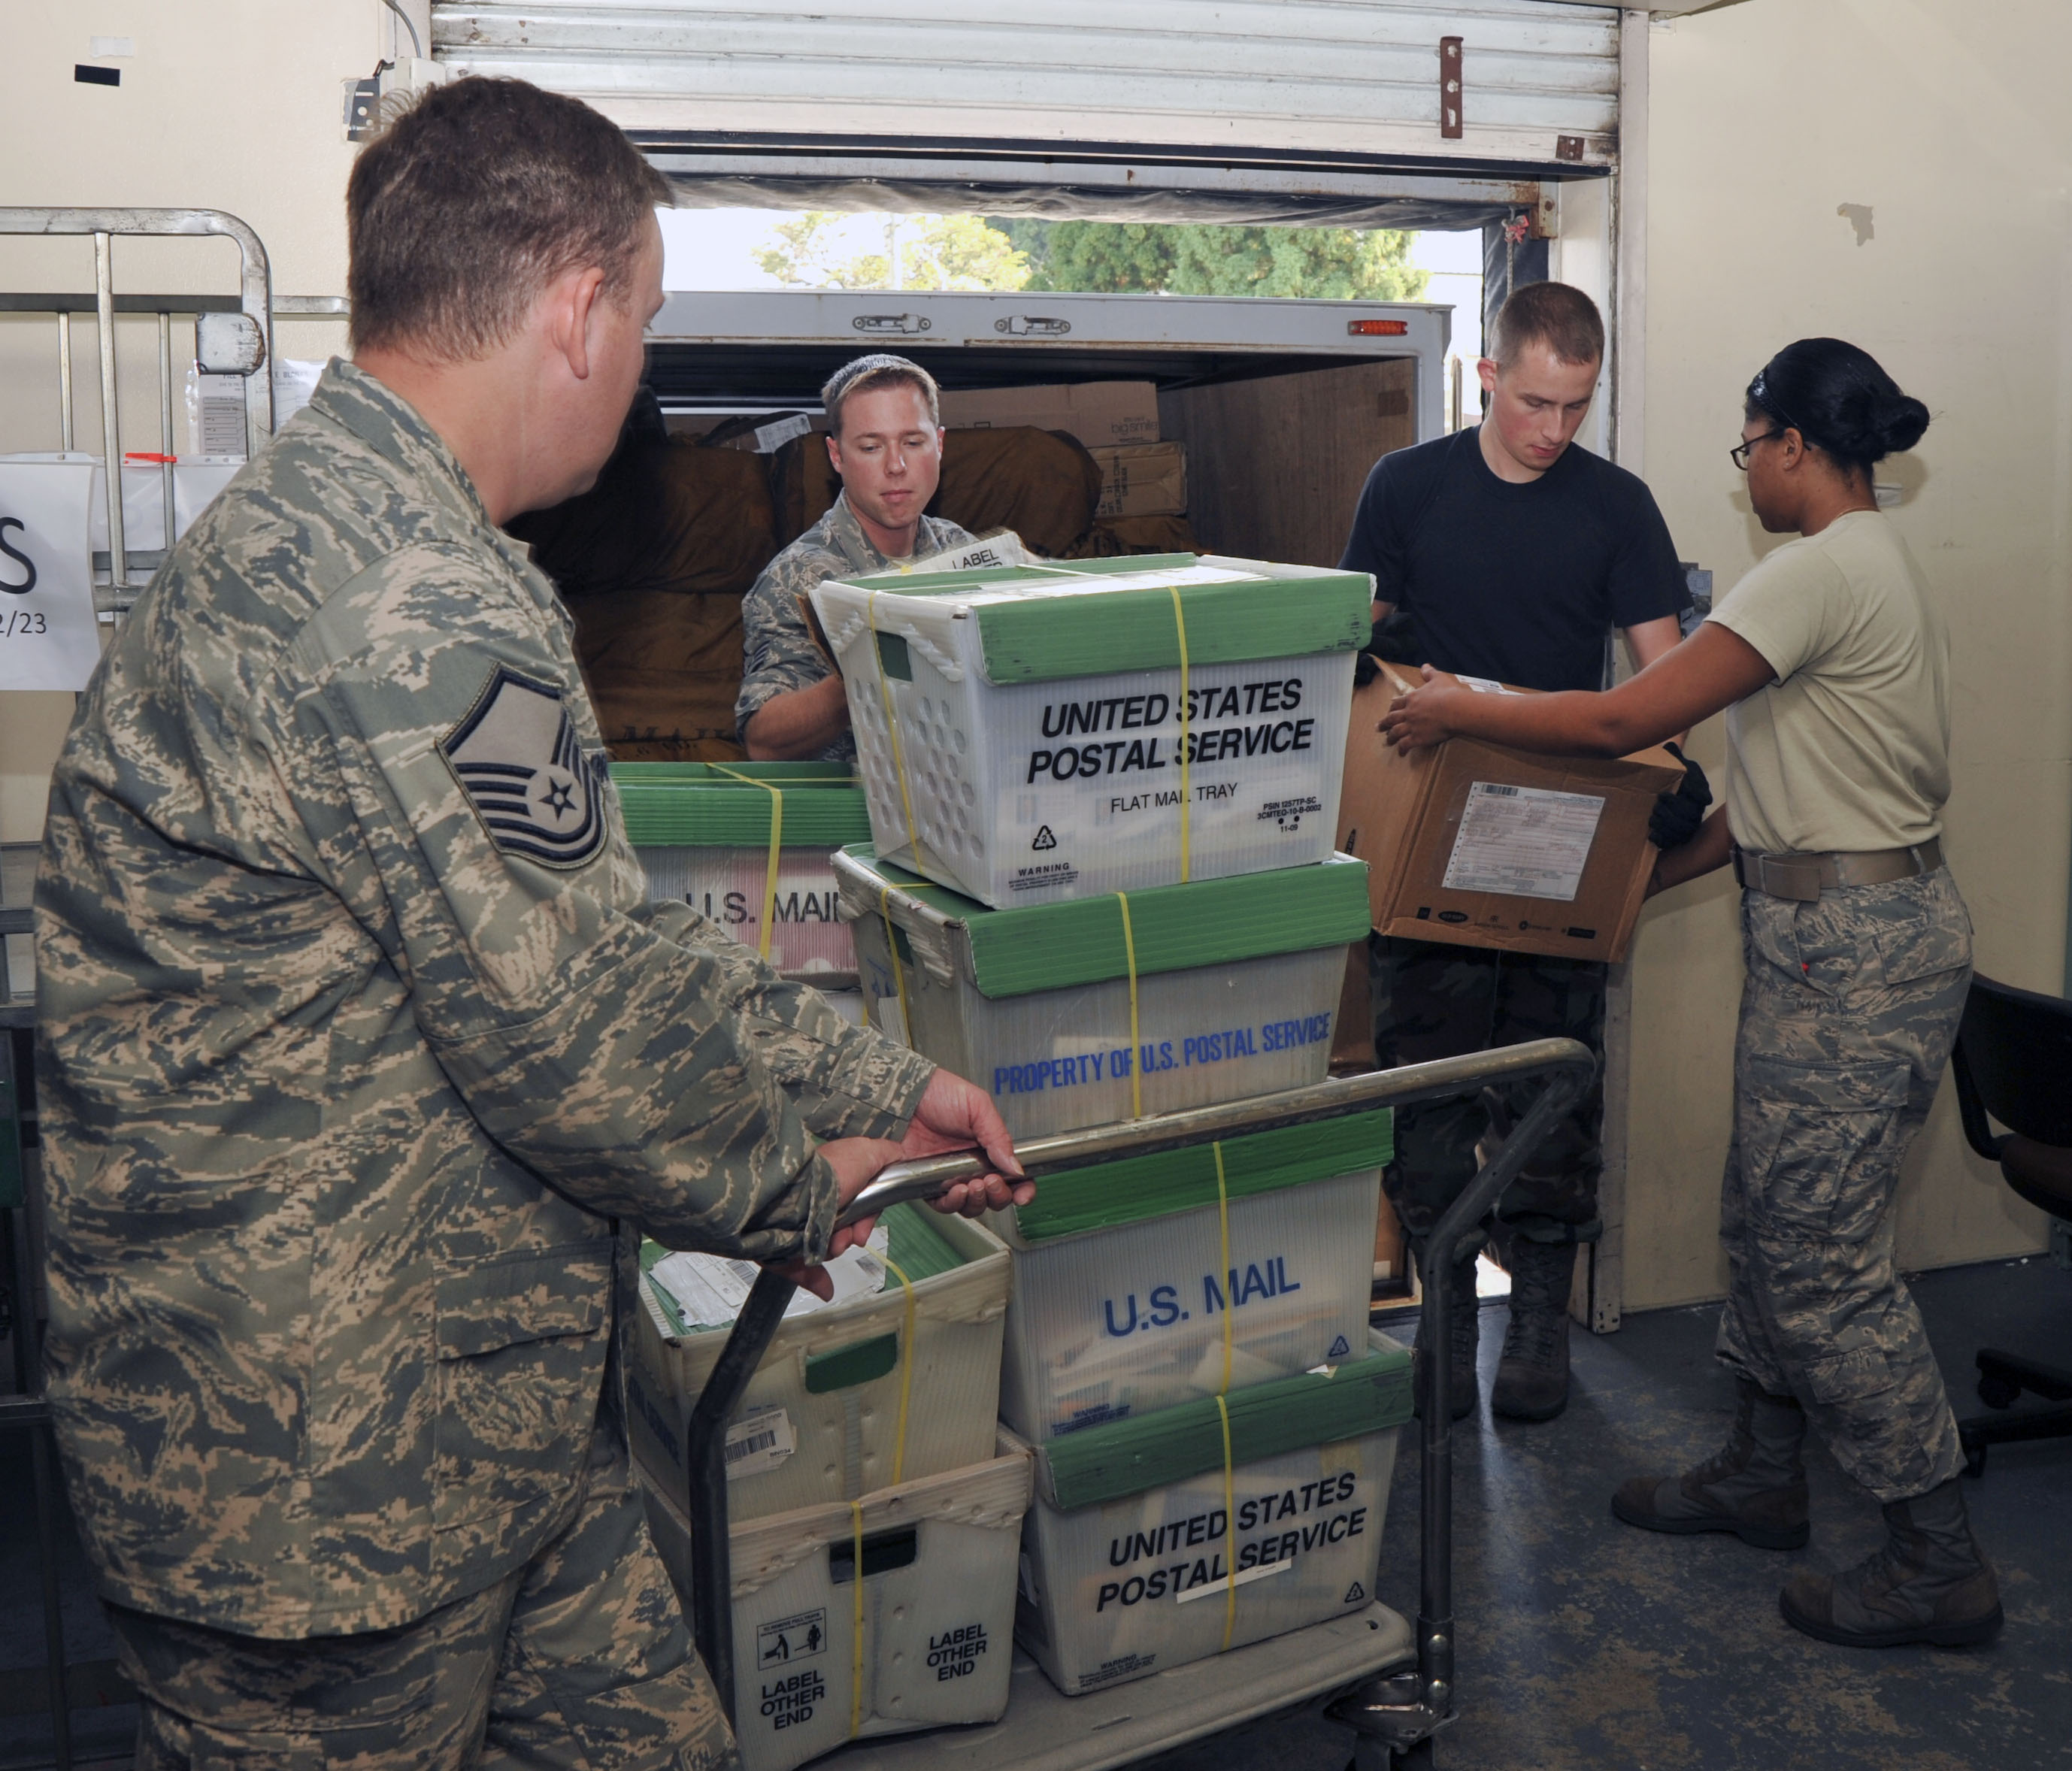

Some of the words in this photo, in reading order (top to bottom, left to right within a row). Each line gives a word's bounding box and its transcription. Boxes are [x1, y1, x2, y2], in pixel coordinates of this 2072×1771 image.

[1042, 694, 1169, 738] UNITED
[1176, 679, 1303, 722] STATES
[1027, 738, 1166, 784] POSTAL
[1174, 719, 1315, 767] SERVICE
[1111, 794, 1151, 813] FLAT
[1196, 783, 1237, 801] TRAY
[1018, 862, 1070, 877] WARNING
[995, 1053, 1104, 1095] PROPERTY
[1110, 1049, 1134, 1078] OF
[1141, 1043, 1178, 1073] U.S.
[1184, 1028, 1257, 1067] POSTAL
[1262, 1012, 1331, 1051] SERVICE
[1104, 1285, 1189, 1337] U.S.
[1204, 1256, 1301, 1314] MAIL
[1110, 1509, 1227, 1567] UNITED
[1238, 1472, 1356, 1530] STATES
[1096, 1554, 1228, 1612] POSTAL
[1238, 1507, 1367, 1571] SERVICE
[929, 1624, 987, 1651] LABEL
[927, 1639, 987, 1667] OTHER
[762, 1670, 825, 1700] LABEL
[938, 1660, 975, 1682] END
[760, 1685, 825, 1716] OTHER
[774, 1706, 813, 1730] END
